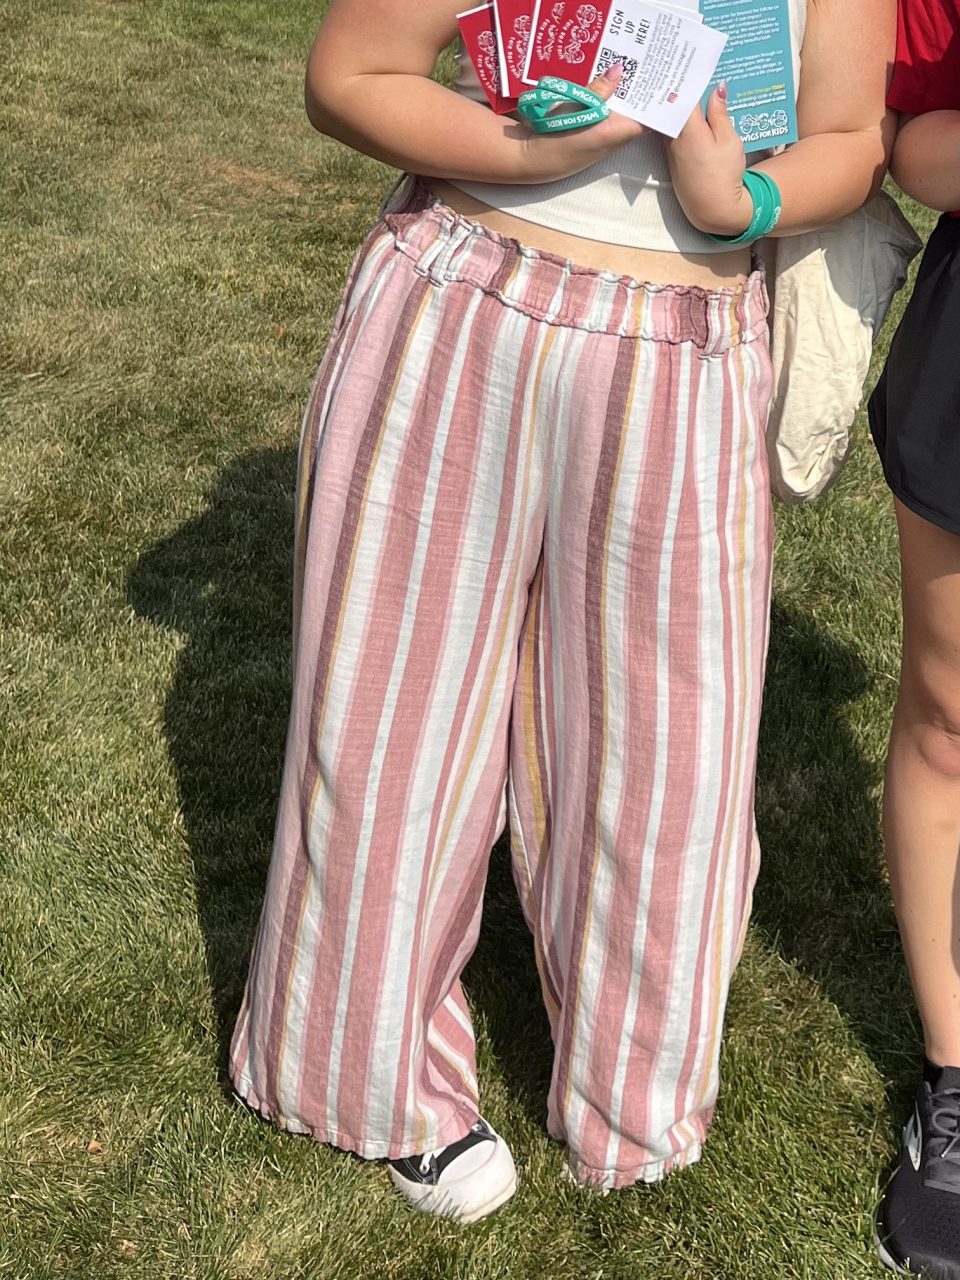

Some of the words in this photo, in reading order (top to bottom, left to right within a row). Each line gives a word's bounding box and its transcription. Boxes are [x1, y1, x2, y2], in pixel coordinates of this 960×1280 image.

[610, 9, 624, 35] SIGN
[624, 20, 636, 34] UP
[635, 19, 651, 45] HERE!
[572, 88, 593, 103] WIGS
[546, 120, 563, 128] KIDS
[563, 117, 576, 125] FOR
[576, 112, 599, 123] WIGS
[740, 134, 759, 142] WIGS
[760, 131, 771, 139] FOR
[772, 126, 788, 136] KIDS
